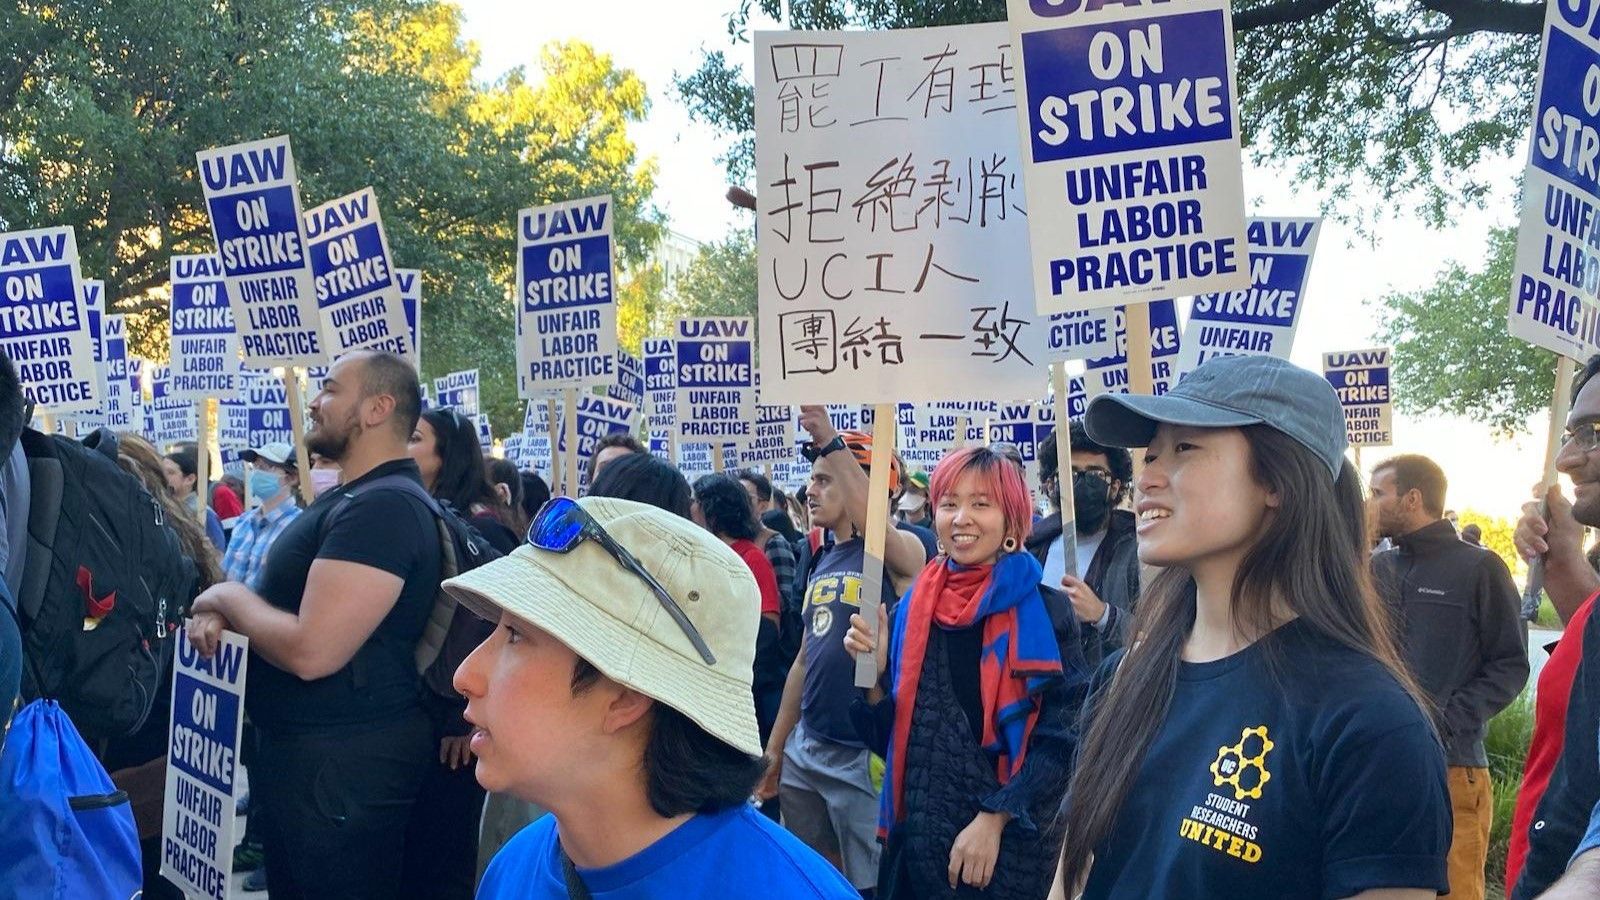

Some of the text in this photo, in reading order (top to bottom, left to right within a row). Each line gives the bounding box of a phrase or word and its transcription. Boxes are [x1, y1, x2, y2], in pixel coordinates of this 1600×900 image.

[1088, 24, 1164, 80] ON
[1583, 63, 1600, 117] O
[1038, 76, 1225, 146] STRIKE
[1538, 106, 1600, 186] STR
[202, 145, 285, 191] UAW
[1066, 154, 1207, 206] UNFAIR
[236, 196, 270, 231] ON
[304, 194, 368, 240] UAW
[523, 202, 608, 240] UAW
[1077, 199, 1203, 248] LABOR
[1544, 183, 1600, 251] UNFA
[1248, 221, 1314, 248] AW
[0, 233, 66, 266] AW
[222, 231, 302, 270] STRIKE
[328, 233, 359, 267] ON
[548, 244, 582, 273] ON
[315, 255, 388, 301] STRIKE
[1050, 238, 1237, 296] PRACTICE
[1251, 257, 1274, 285] N
[1542, 233, 1600, 300] LABO
[5, 273, 44, 302] ON
[192, 283, 217, 306] ON
[239, 276, 298, 304] UNFAIR
[527, 272, 609, 306] STRIKE
[331, 296, 387, 328] UNFAIR
[1196, 288, 1296, 318] STRIKE
[1516, 272, 1600, 348] PRACTI
[0, 300, 77, 332] TRIKE
[174, 306, 235, 330] STRIKE
[248, 304, 302, 330] LABOR
[538, 309, 600, 334] UNFAIR
[339, 318, 389, 349] LABOR
[680, 320, 748, 337] UAW
[1050, 318, 1108, 348] CTICE
[1200, 326, 1273, 352] UNFAIR
[181, 339, 226, 354] UNFAIR
[243, 331, 320, 357] PRACTICE
[541, 333, 598, 357] LABOR
[645, 341, 675, 354] UA
[778, 301, 1034, 380] 團結一致
[700, 343, 728, 362] ON
[1328, 351, 1386, 367] UAW
[19, 361, 72, 383] ABOR
[152, 367, 170, 380] UA
[183, 356, 224, 373] LABOR
[530, 355, 613, 381] PRACTICE
[680, 363, 749, 383] STRIKE
[1102, 361, 1171, 388] UNIR
[174, 374, 234, 391] PRACTICE
[449, 372, 477, 388] UAW
[622, 371, 638, 389] ON
[646, 374, 675, 388] STRI
[1344, 370, 1369, 386] ON
[24, 381, 92, 405] ACTICE
[653, 392, 675, 403] UNF
[689, 391, 741, 404] UNFAIR
[1338, 385, 1388, 403] TRIKE
[160, 410, 187, 420] UNFAIR
[262, 410, 284, 428] ON
[655, 404, 676, 414] LAB
[692, 406, 738, 420] LABOR
[756, 405, 790, 421] RIKE
[930, 414, 973, 427] LAB
[1001, 405, 1031, 420] AW
[1345, 407, 1381, 419] NFAIR
[162, 420, 187, 430] LABOR
[583, 418, 609, 438] ON
[649, 416, 676, 426] PRAC
[681, 422, 750, 435] PRACTICE
[756, 424, 785, 436] NFAIR
[830, 412, 857, 430] TICE
[1346, 420, 1379, 431] ABOR
[158, 429, 193, 440] PRACTICE
[249, 429, 292, 449] STRIK
[749, 437, 784, 449] LABOR
[921, 427, 984, 442] PRACCE
[990, 425, 1014, 441] ON
[1348, 431, 1389, 443] ACTICE
[681, 443, 709, 452] UNFAIR
[683, 453, 706, 461] LABOR
[741, 449, 794, 462] PRACTICE
[901, 449, 940, 461] PRACTICE
[678, 463, 712, 471] PRACTICE
[773, 463, 789, 472] ABO
[792, 465, 811, 475] PRAC
[192, 688, 217, 732] ON
[173, 723, 234, 785] STRIKE
[1220, 758, 1237, 774] UC
[176, 777, 222, 828] UNFAIR
[1205, 793, 1250, 818] STUDENT
[1190, 805, 1259, 840] RESEARCHERS
[176, 810, 217, 861] LABOR
[1179, 818, 1263, 863] UNITED
[165, 836, 225, 900] PRACTICE
